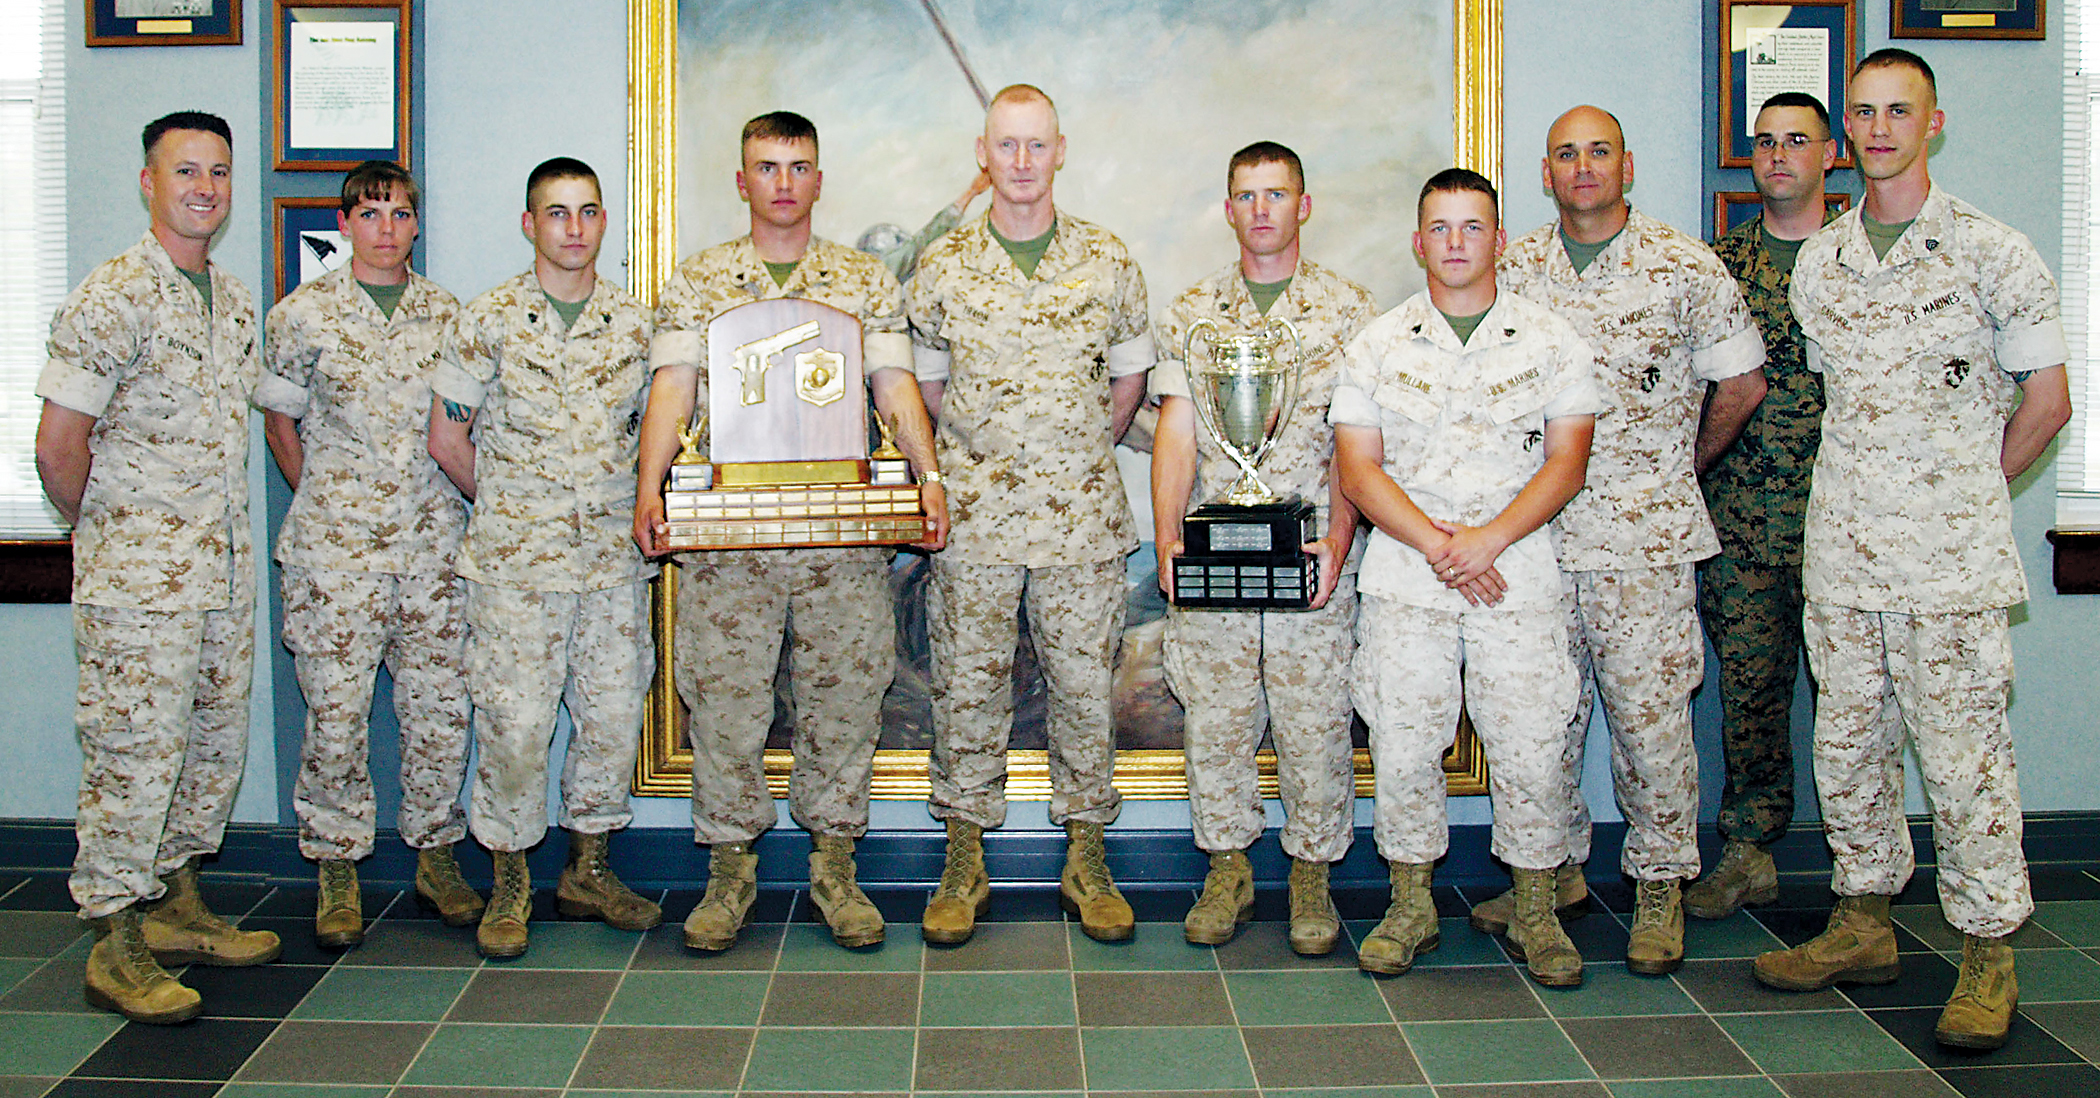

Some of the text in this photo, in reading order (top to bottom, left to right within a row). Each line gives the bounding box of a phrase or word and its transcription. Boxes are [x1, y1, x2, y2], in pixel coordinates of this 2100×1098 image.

[1600, 306, 1654, 333] U.S. MARINES
[1820, 304, 1849, 329] CARVER
[1904, 291, 1960, 325] U.S. MARINES
[167, 336, 203, 361] BOYNTON
[1302, 340, 1332, 362] ARINES
[1396, 371, 1433, 394] MULLANE
[1488, 367, 1540, 396] U.S. MARINES
